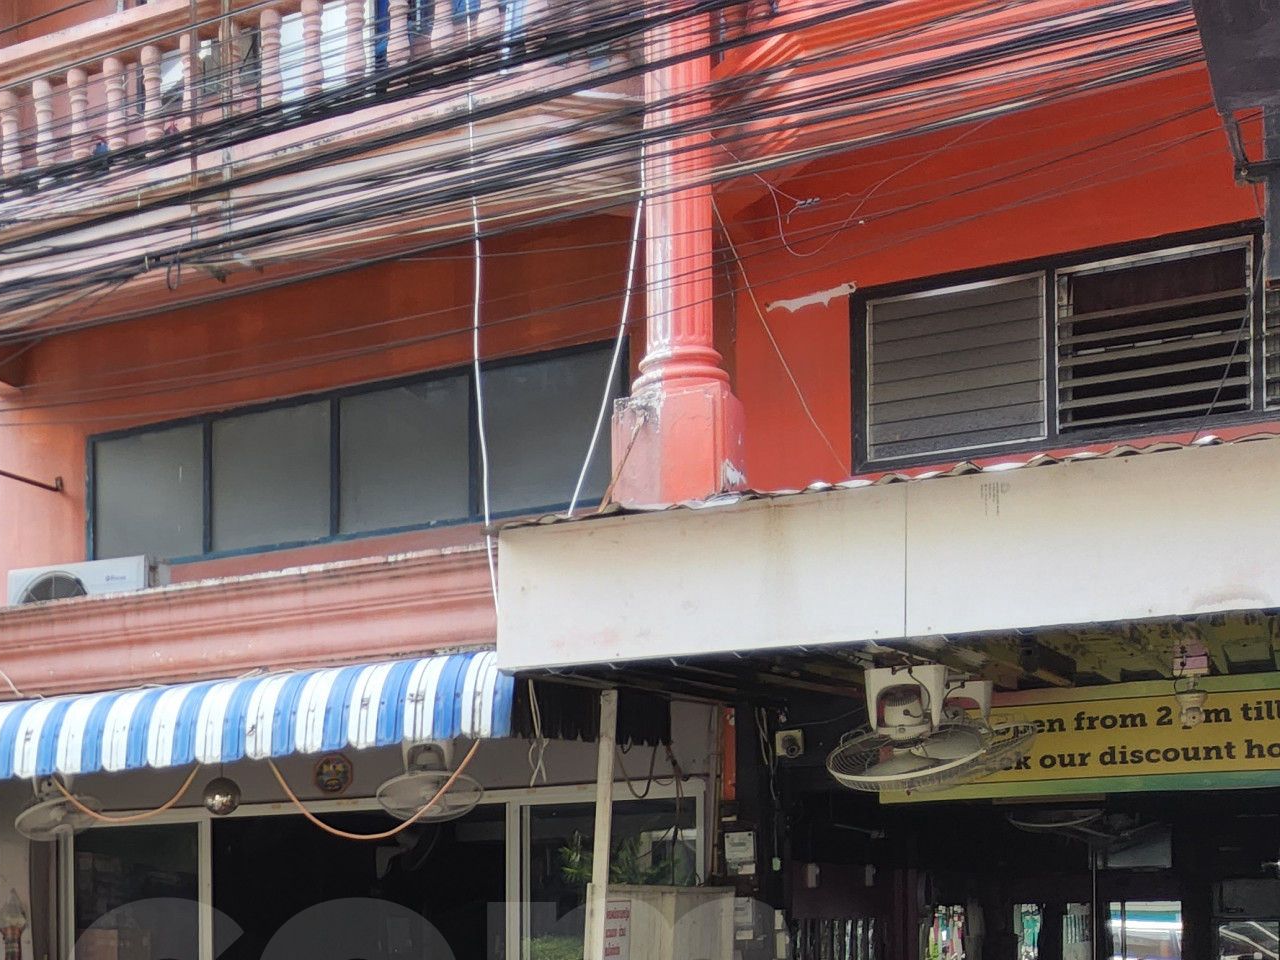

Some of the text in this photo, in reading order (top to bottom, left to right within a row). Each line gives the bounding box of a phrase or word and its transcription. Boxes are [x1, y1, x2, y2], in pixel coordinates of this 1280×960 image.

[1074, 711, 1148, 731] from
[1156, 706, 1173, 726] 2
[1181, 707, 1232, 730] m
[1039, 751, 1091, 769] our
[1099, 740, 1236, 766] discount
